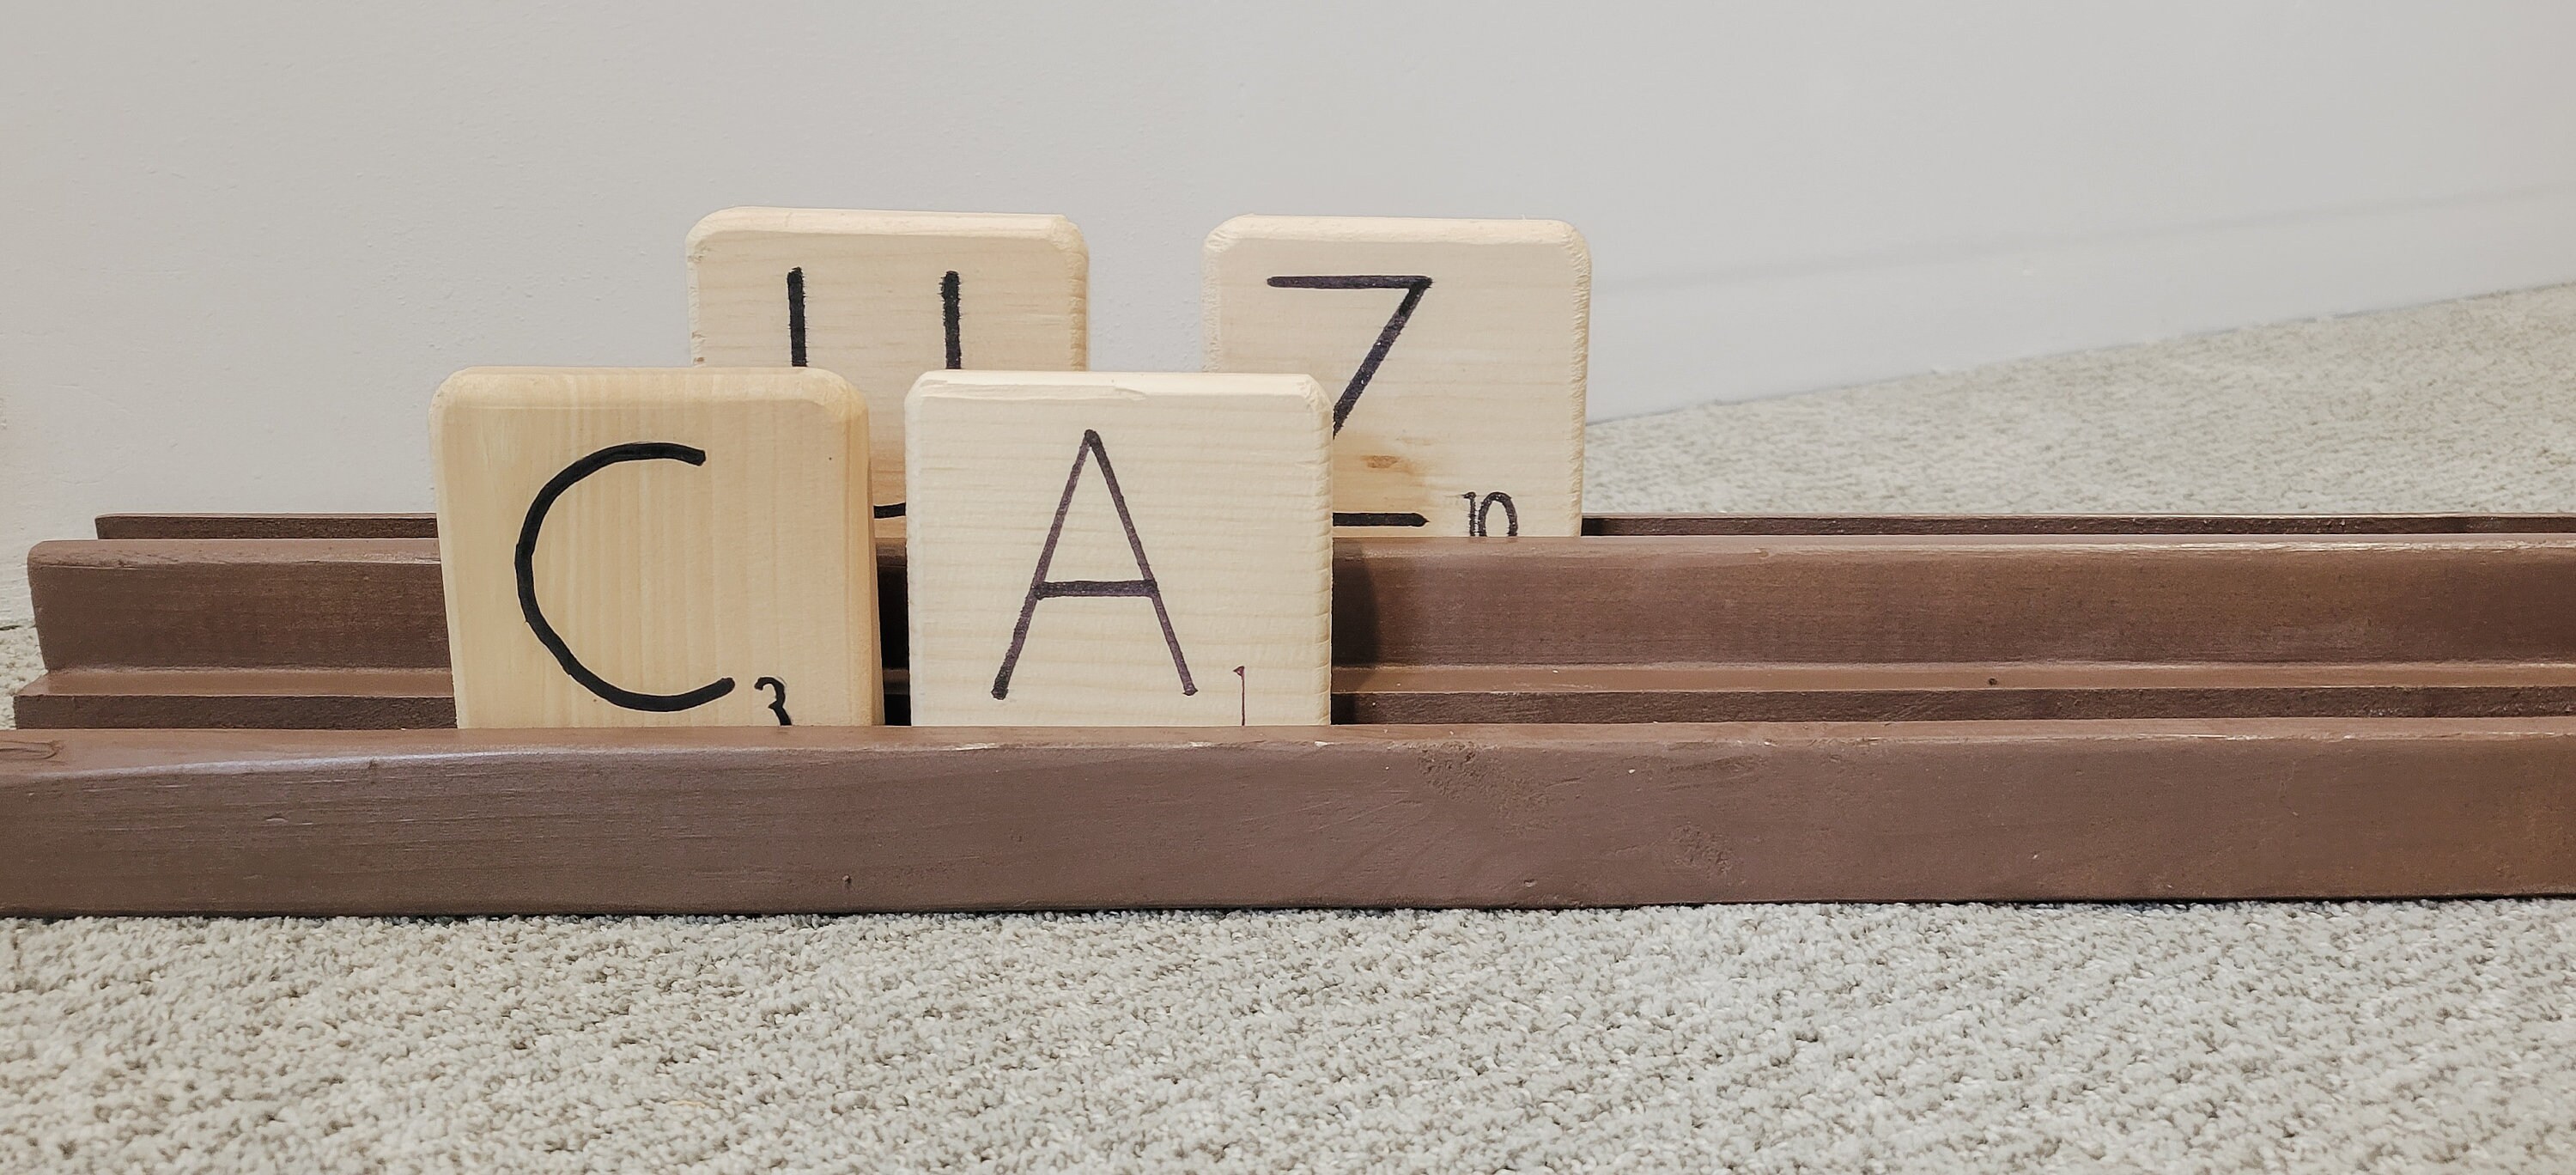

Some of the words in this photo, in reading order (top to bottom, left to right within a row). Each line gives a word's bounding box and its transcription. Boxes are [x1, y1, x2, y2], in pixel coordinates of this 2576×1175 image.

[1267, 274, 1434, 527] Z
[1461, 491, 1519, 536] 10
[513, 441, 736, 713] C
[753, 676, 793, 726] 3
[990, 429, 1199, 701] A
[1232, 665, 1246, 726] 1
